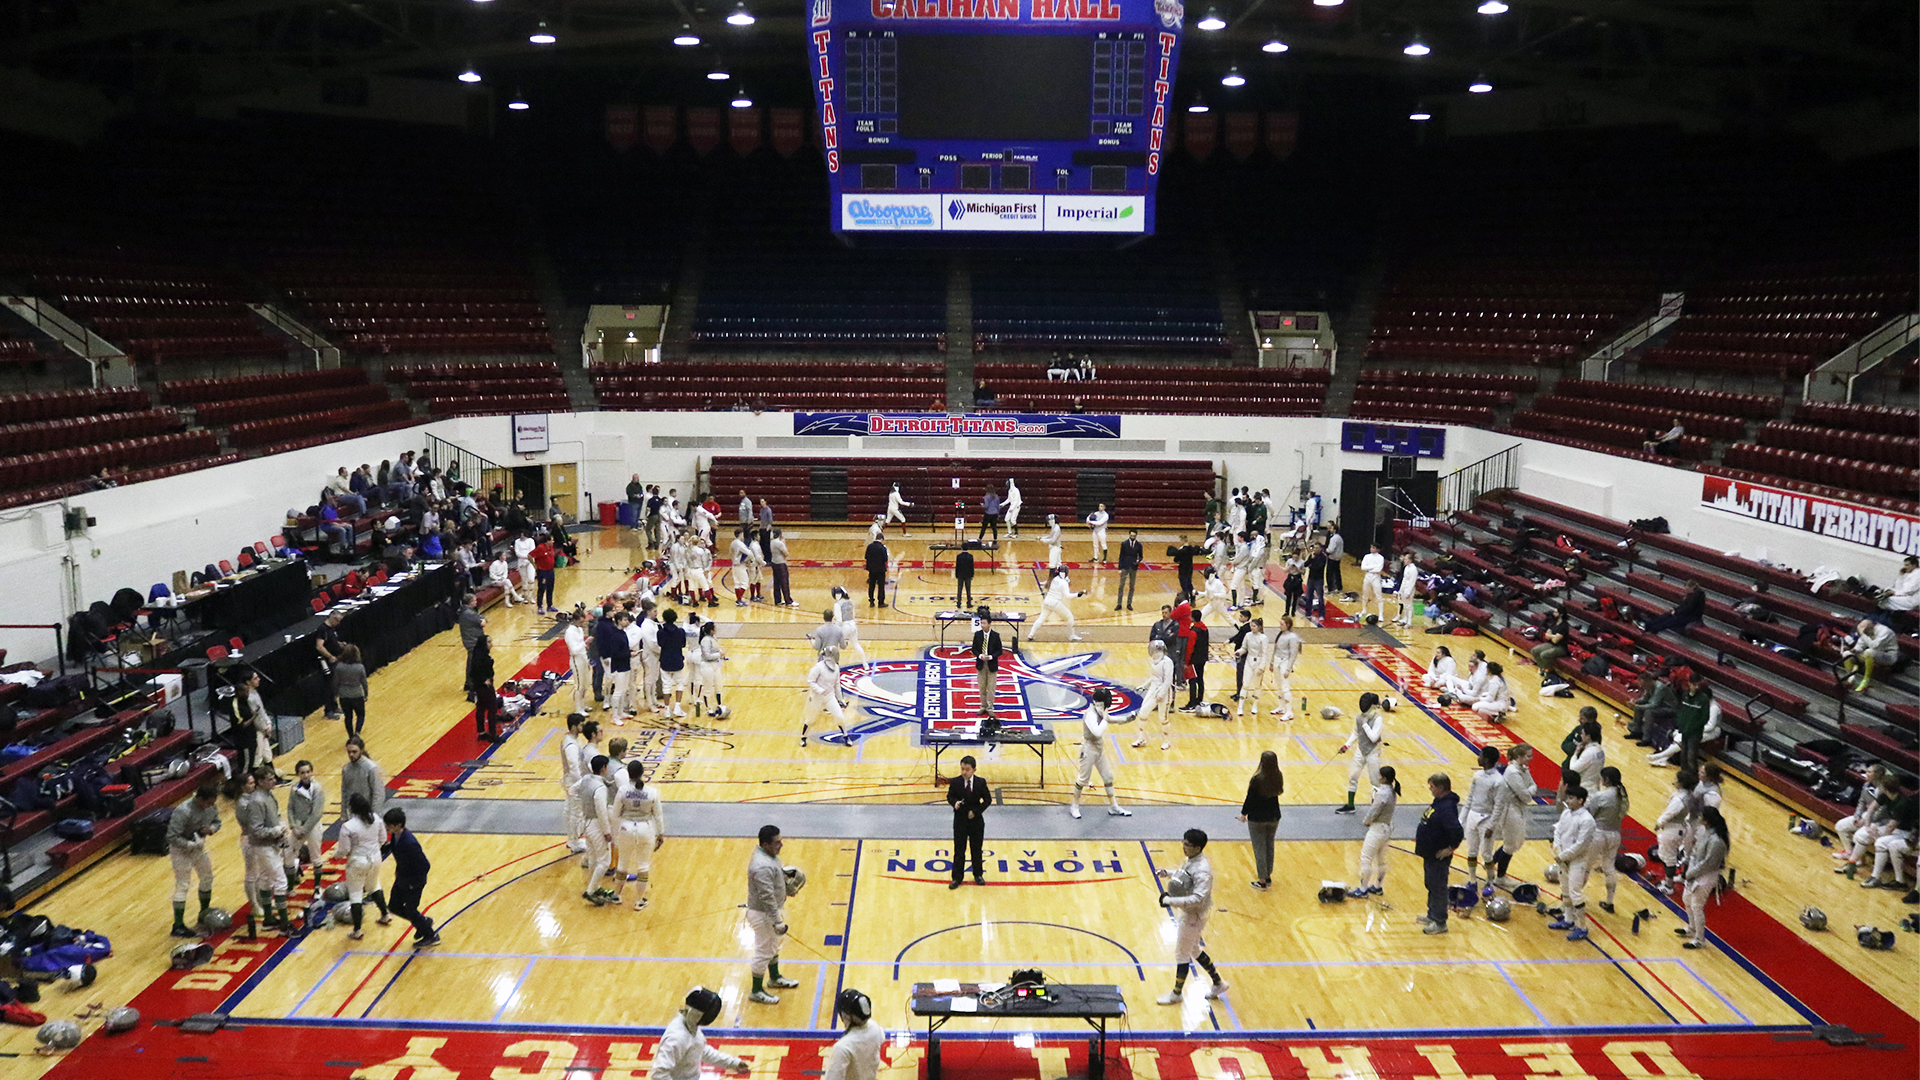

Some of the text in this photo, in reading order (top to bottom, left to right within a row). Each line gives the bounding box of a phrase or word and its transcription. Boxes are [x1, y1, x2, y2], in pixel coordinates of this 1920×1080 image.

[871, 0, 1120, 20] CALIHAN HALL
[813, 30, 839, 173] TITANS
[1149, 32, 1176, 175] TITANS
[848, 199, 932, 227] Absopure
[966, 203, 1037, 215] Michigan First
[1057, 205, 1118, 221] Imperial
[1748, 488, 1807, 529] TITAN
[923, 661, 941, 718] DETROIT MERCY
